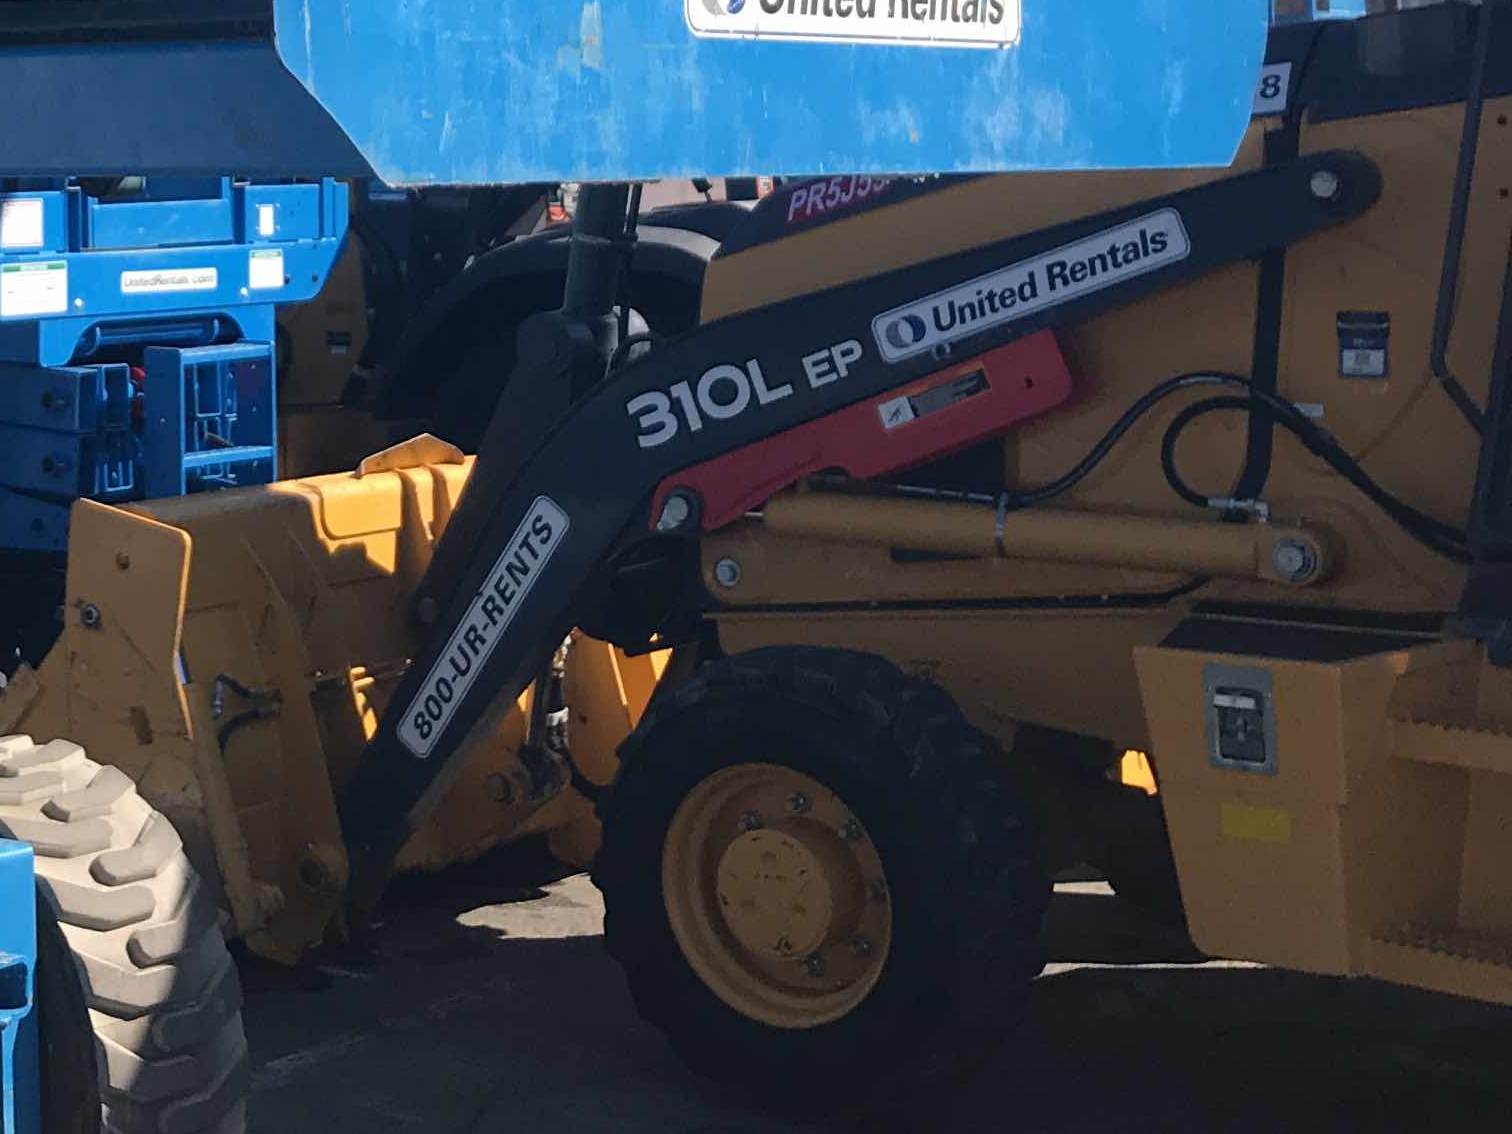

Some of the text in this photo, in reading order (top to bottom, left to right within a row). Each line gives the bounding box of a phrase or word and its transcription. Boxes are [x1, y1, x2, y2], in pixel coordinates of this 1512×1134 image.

[932, 228, 1169, 333] United Rentals
[626, 338, 864, 448] 310L EP
[413, 513, 554, 741] 800-UR-RENTS
